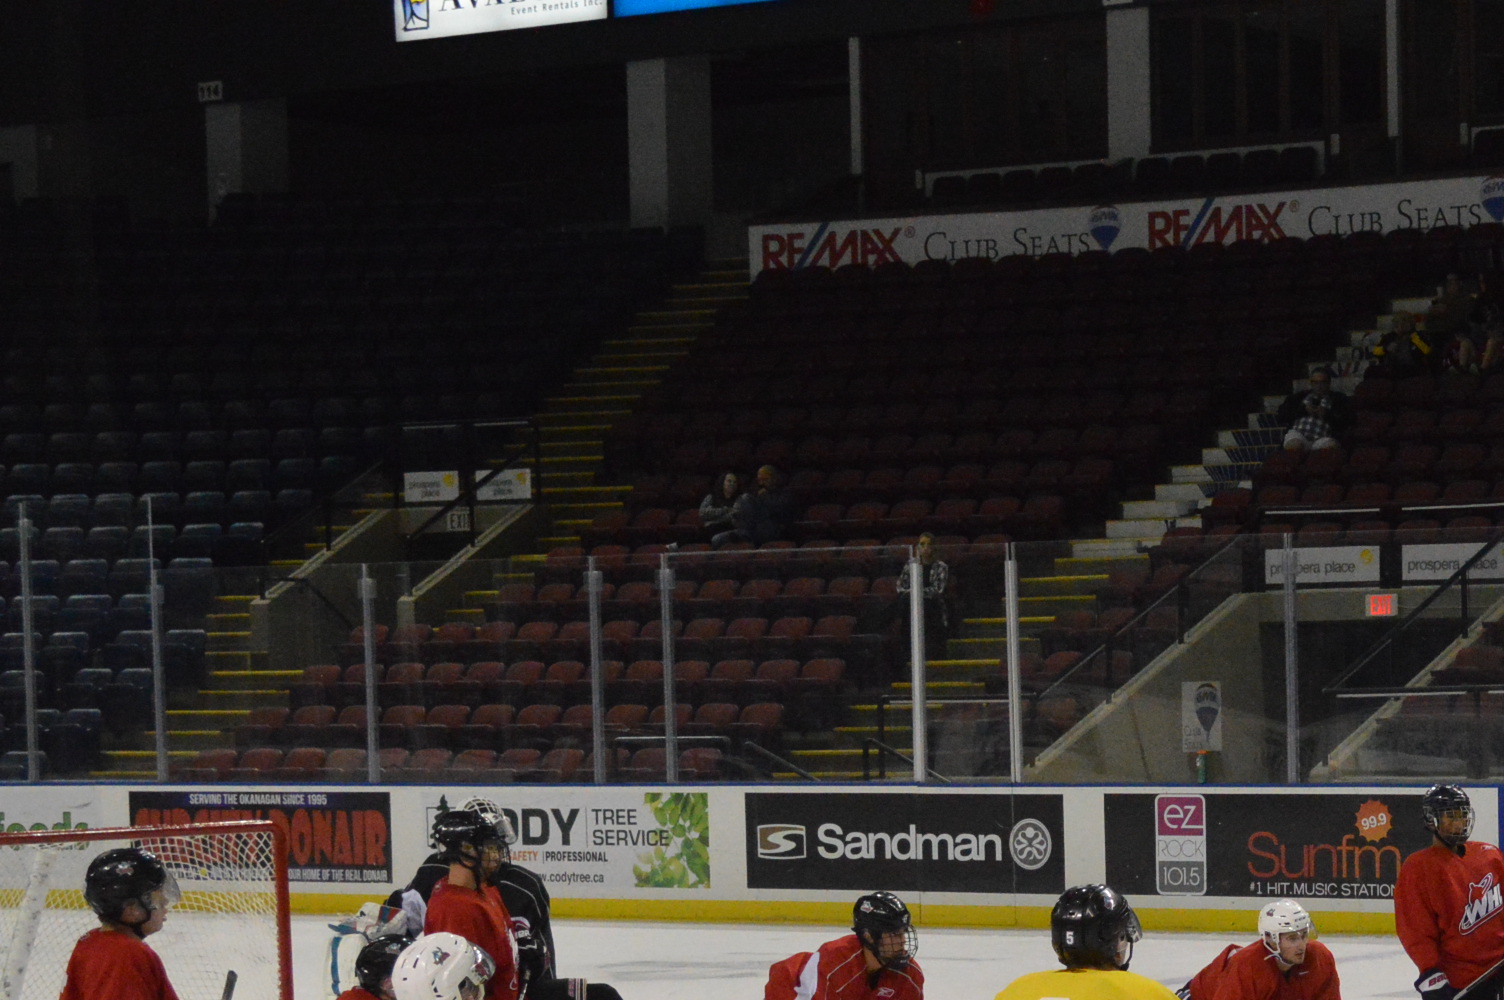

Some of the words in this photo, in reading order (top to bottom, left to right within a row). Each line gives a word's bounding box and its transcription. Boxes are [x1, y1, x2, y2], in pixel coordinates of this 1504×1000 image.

[511, 5, 538, 16] Event
[542, 1, 579, 12] Rentals
[1324, 559, 1356, 576] place
[1407, 558, 1460, 575] prospera
[1370, 595, 1392, 616] EXIT
[188, 793, 222, 806] SERVING
[223, 793, 238, 806] THE
[239, 793, 282, 806] OKANAGAN
[282, 793, 306, 806] SINCE
[307, 793, 327, 806] 1995
[591, 808, 637, 825] TREE
[1163, 803, 1204, 830] ez
[1361, 812, 1387, 830] 99.9
[592, 829, 670, 847] SERVICE
[817, 823, 1002, 862] Sandman
[545, 850, 609, 862] PROFESSIONAL
[1156, 839, 1204, 858] ROCK
[1248, 830, 1400, 879] Sunfm
[302, 868, 320, 880] HOME
[321, 868, 330, 880] OF
[331, 868, 344, 881] THE
[345, 868, 362, 880] REAL
[363, 868, 388, 881] DONAIR
[1162, 865, 1200, 887] 101.5
[1249, 881, 1263, 895] #1
[1066, 930, 1075, 946] 5
